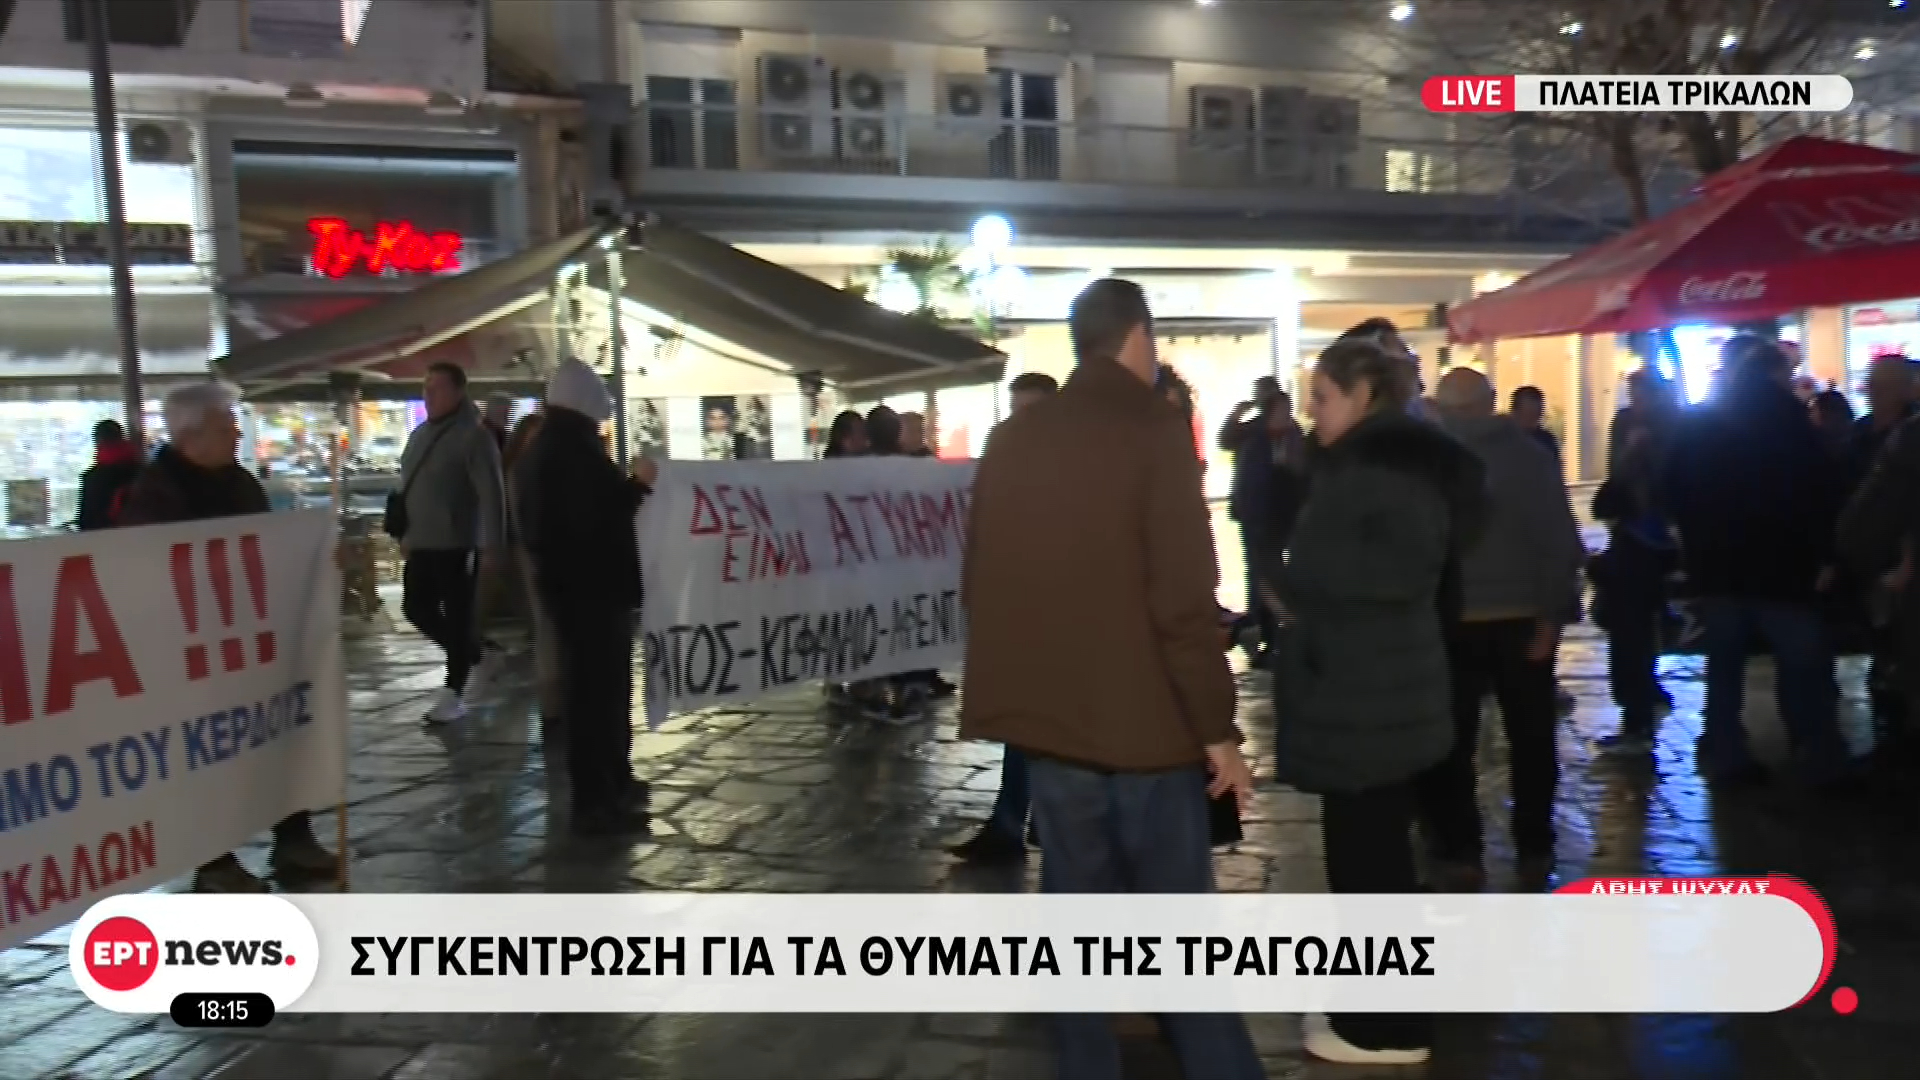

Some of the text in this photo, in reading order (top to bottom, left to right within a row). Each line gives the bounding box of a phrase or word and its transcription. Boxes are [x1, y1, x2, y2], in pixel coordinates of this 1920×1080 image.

[689, 482, 774, 536] ΔΕΝ
[823, 486, 974, 567] ΑΤΥΧΗΜ
[169, 533, 277, 682] !!!
[86, 726, 172, 799] ΤΟΥ
[181, 680, 314, 771] ΚΕΡΔΟΥΣ
[0, 820, 157, 924] ΚΑΛΩΝ
